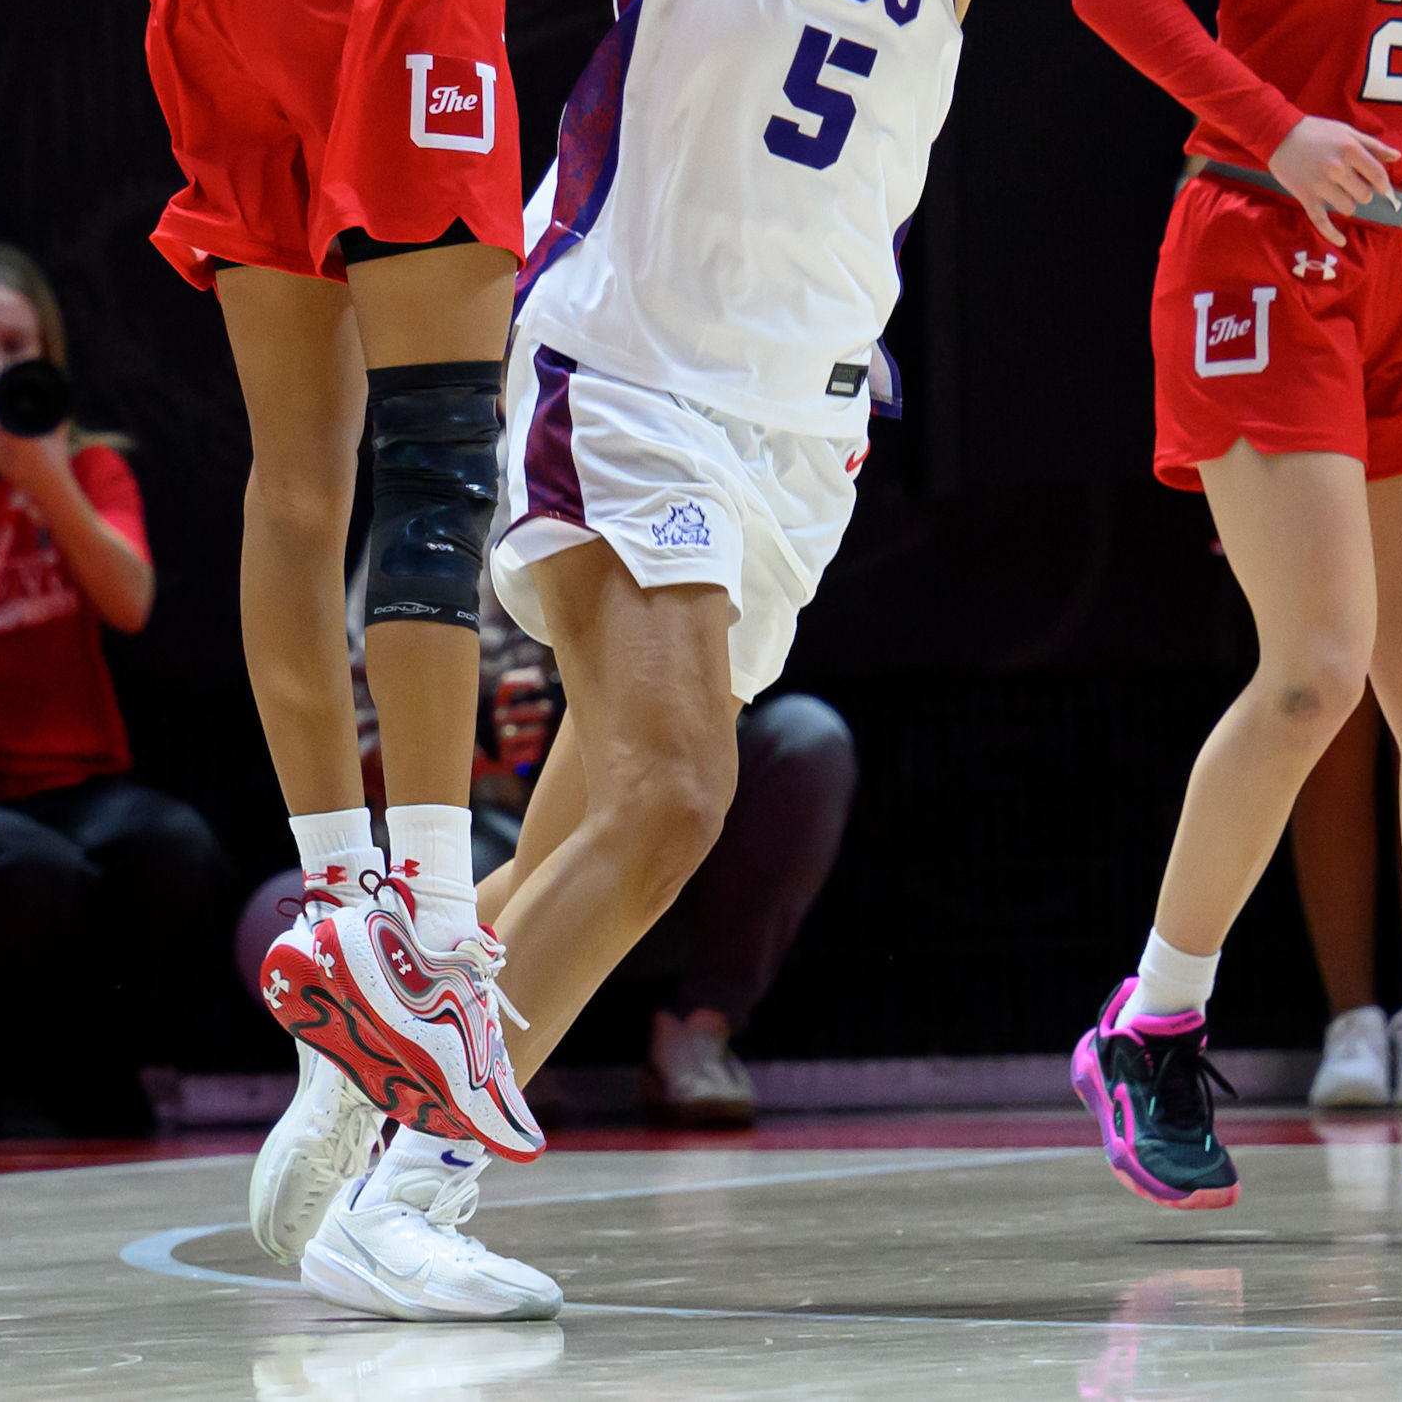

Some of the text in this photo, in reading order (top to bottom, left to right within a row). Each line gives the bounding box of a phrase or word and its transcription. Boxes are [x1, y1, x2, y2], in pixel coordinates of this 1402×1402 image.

[428, 85, 479, 115] The
[763, 24, 878, 170] 5
[1208, 314, 1252, 347] The
